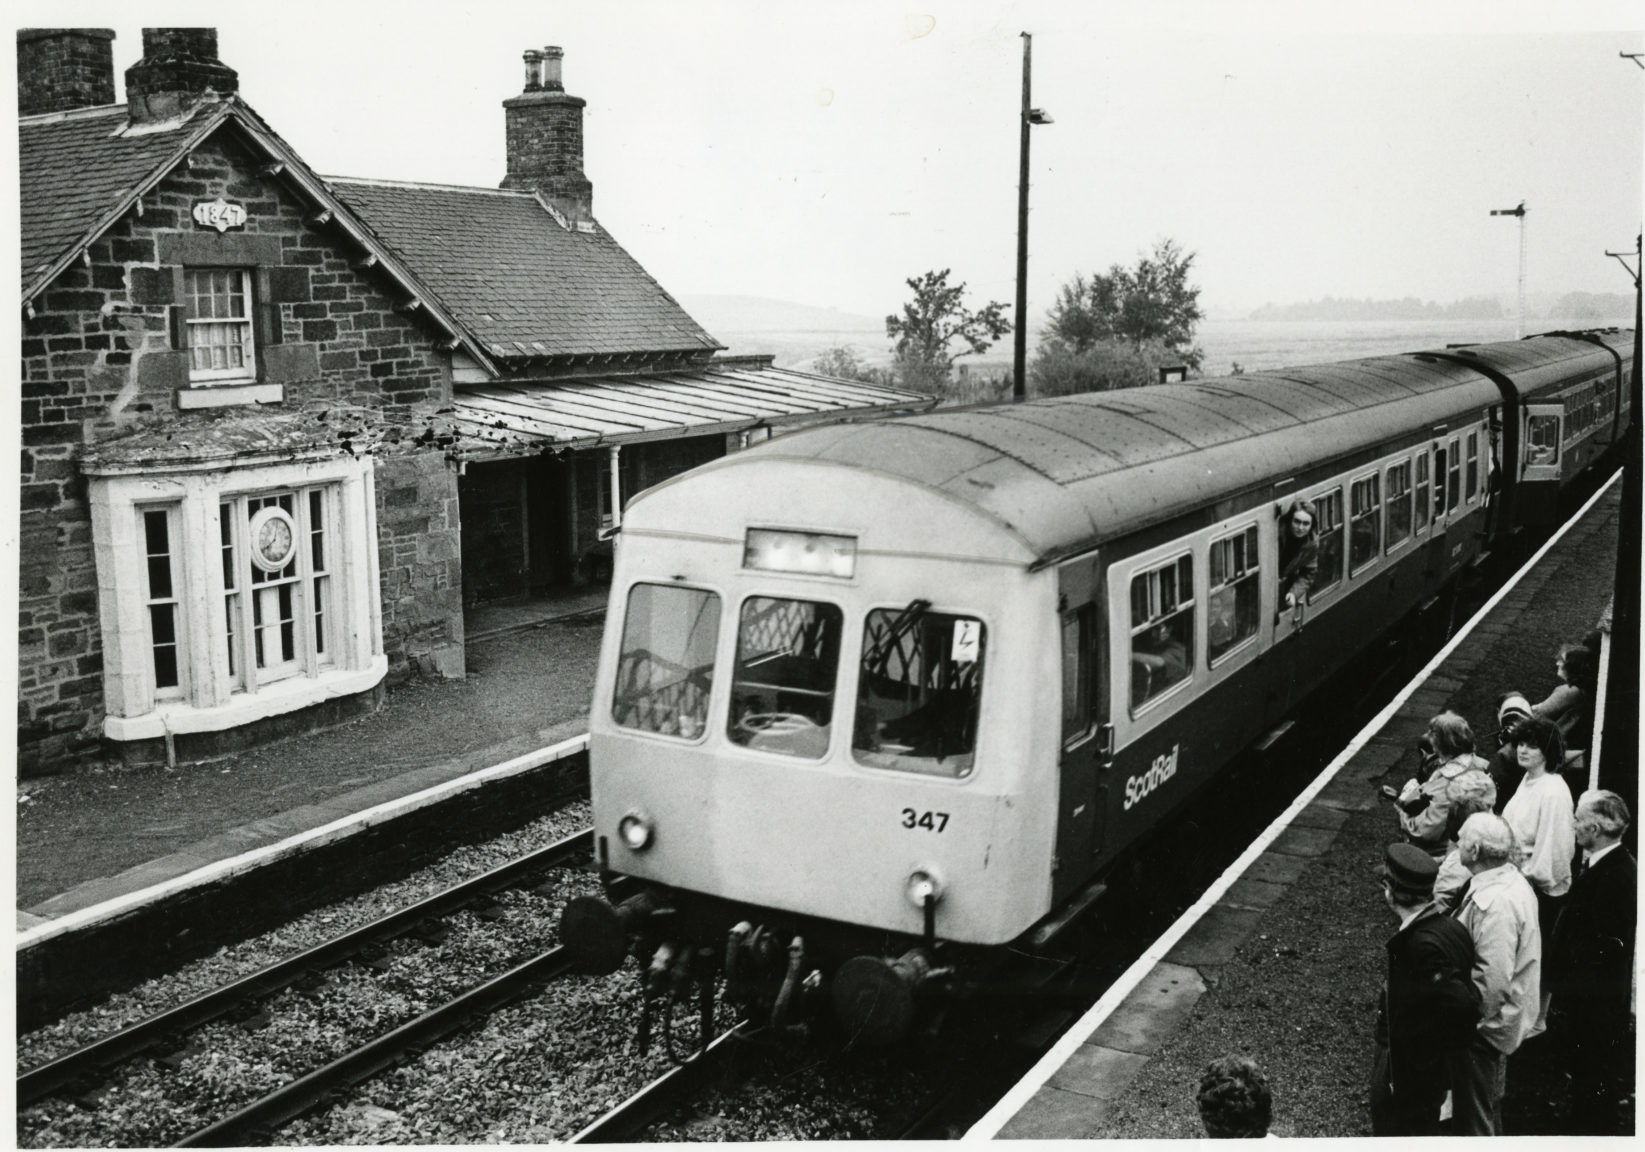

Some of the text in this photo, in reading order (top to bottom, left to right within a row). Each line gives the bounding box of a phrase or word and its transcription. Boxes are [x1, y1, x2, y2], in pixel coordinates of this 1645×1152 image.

[198, 205, 239, 225] 1847
[1123, 743, 1179, 811] ScotRail
[902, 808, 950, 833] 347
